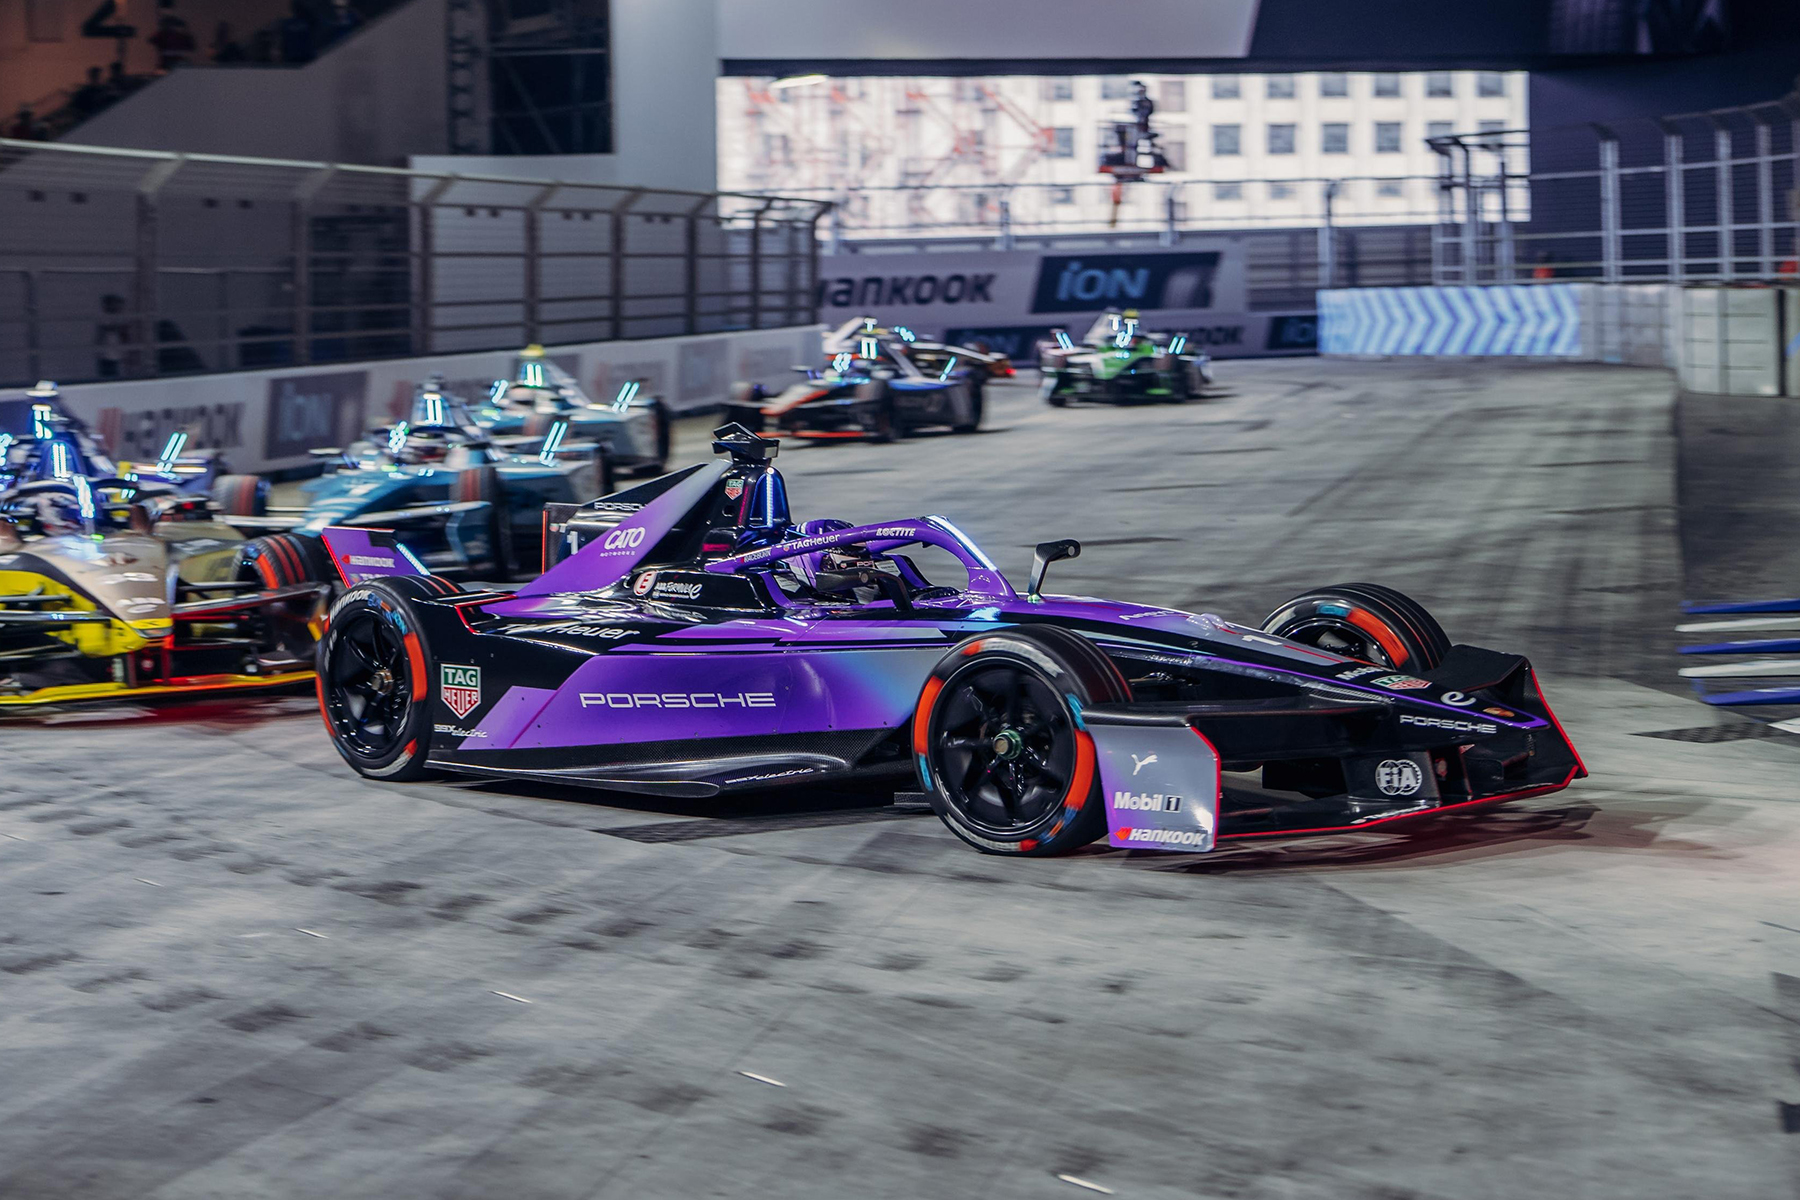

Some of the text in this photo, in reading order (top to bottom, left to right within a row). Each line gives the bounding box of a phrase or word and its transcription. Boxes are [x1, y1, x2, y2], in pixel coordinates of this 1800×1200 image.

[604, 527, 646, 549] CATO
[876, 527, 916, 537] LOCTITE
[567, 531, 579, 555] 1
[444, 668, 477, 686] TAG
[444, 688, 478, 714] HEUER
[579, 693, 777, 708] PORSCHE
[1400, 715, 1497, 734] PORSCHE
[1114, 791, 1163, 811] Mobil
